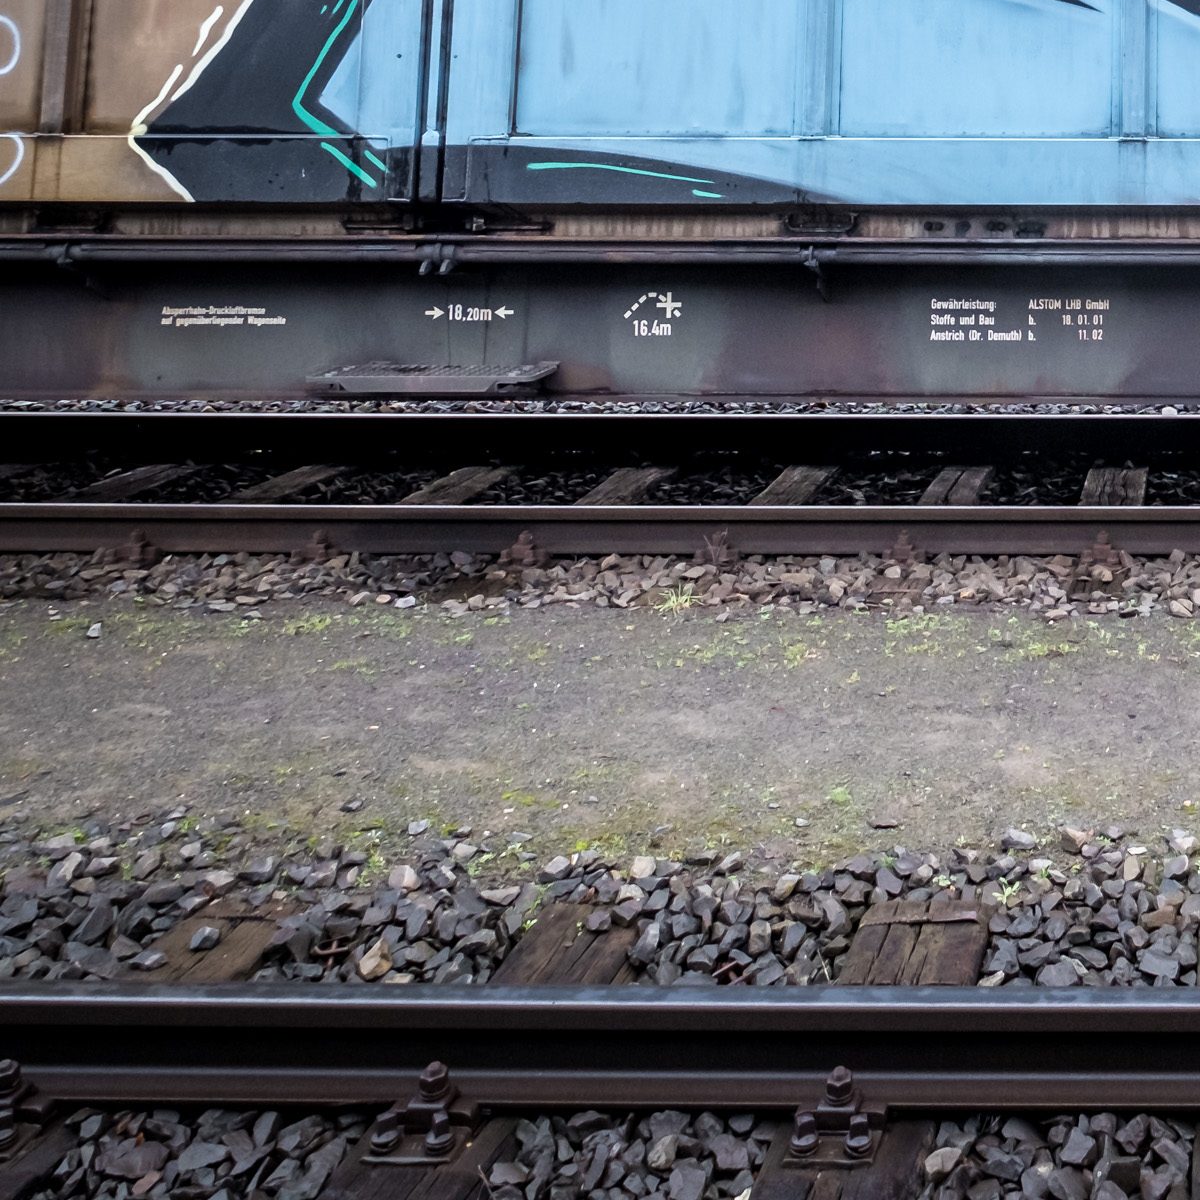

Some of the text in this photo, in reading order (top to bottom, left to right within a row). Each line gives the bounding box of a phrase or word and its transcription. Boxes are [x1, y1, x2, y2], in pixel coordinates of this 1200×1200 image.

[931, 298, 997, 312] Gewährleistung:
[1028, 299, 1110, 310] ALSTOM LHB GmbH
[930, 314, 955, 325] Stoffe
[959, 314, 975, 325] und
[978, 314, 995, 325] Bau
[1028, 314, 1037, 325] b.
[632, 320, 672, 336] 16.4m
[930, 330, 965, 341] Anstrich
[968, 330, 984, 341] (Dr.
[987, 330, 1023, 341] Demuth)
[1028, 330, 1037, 341] b.
